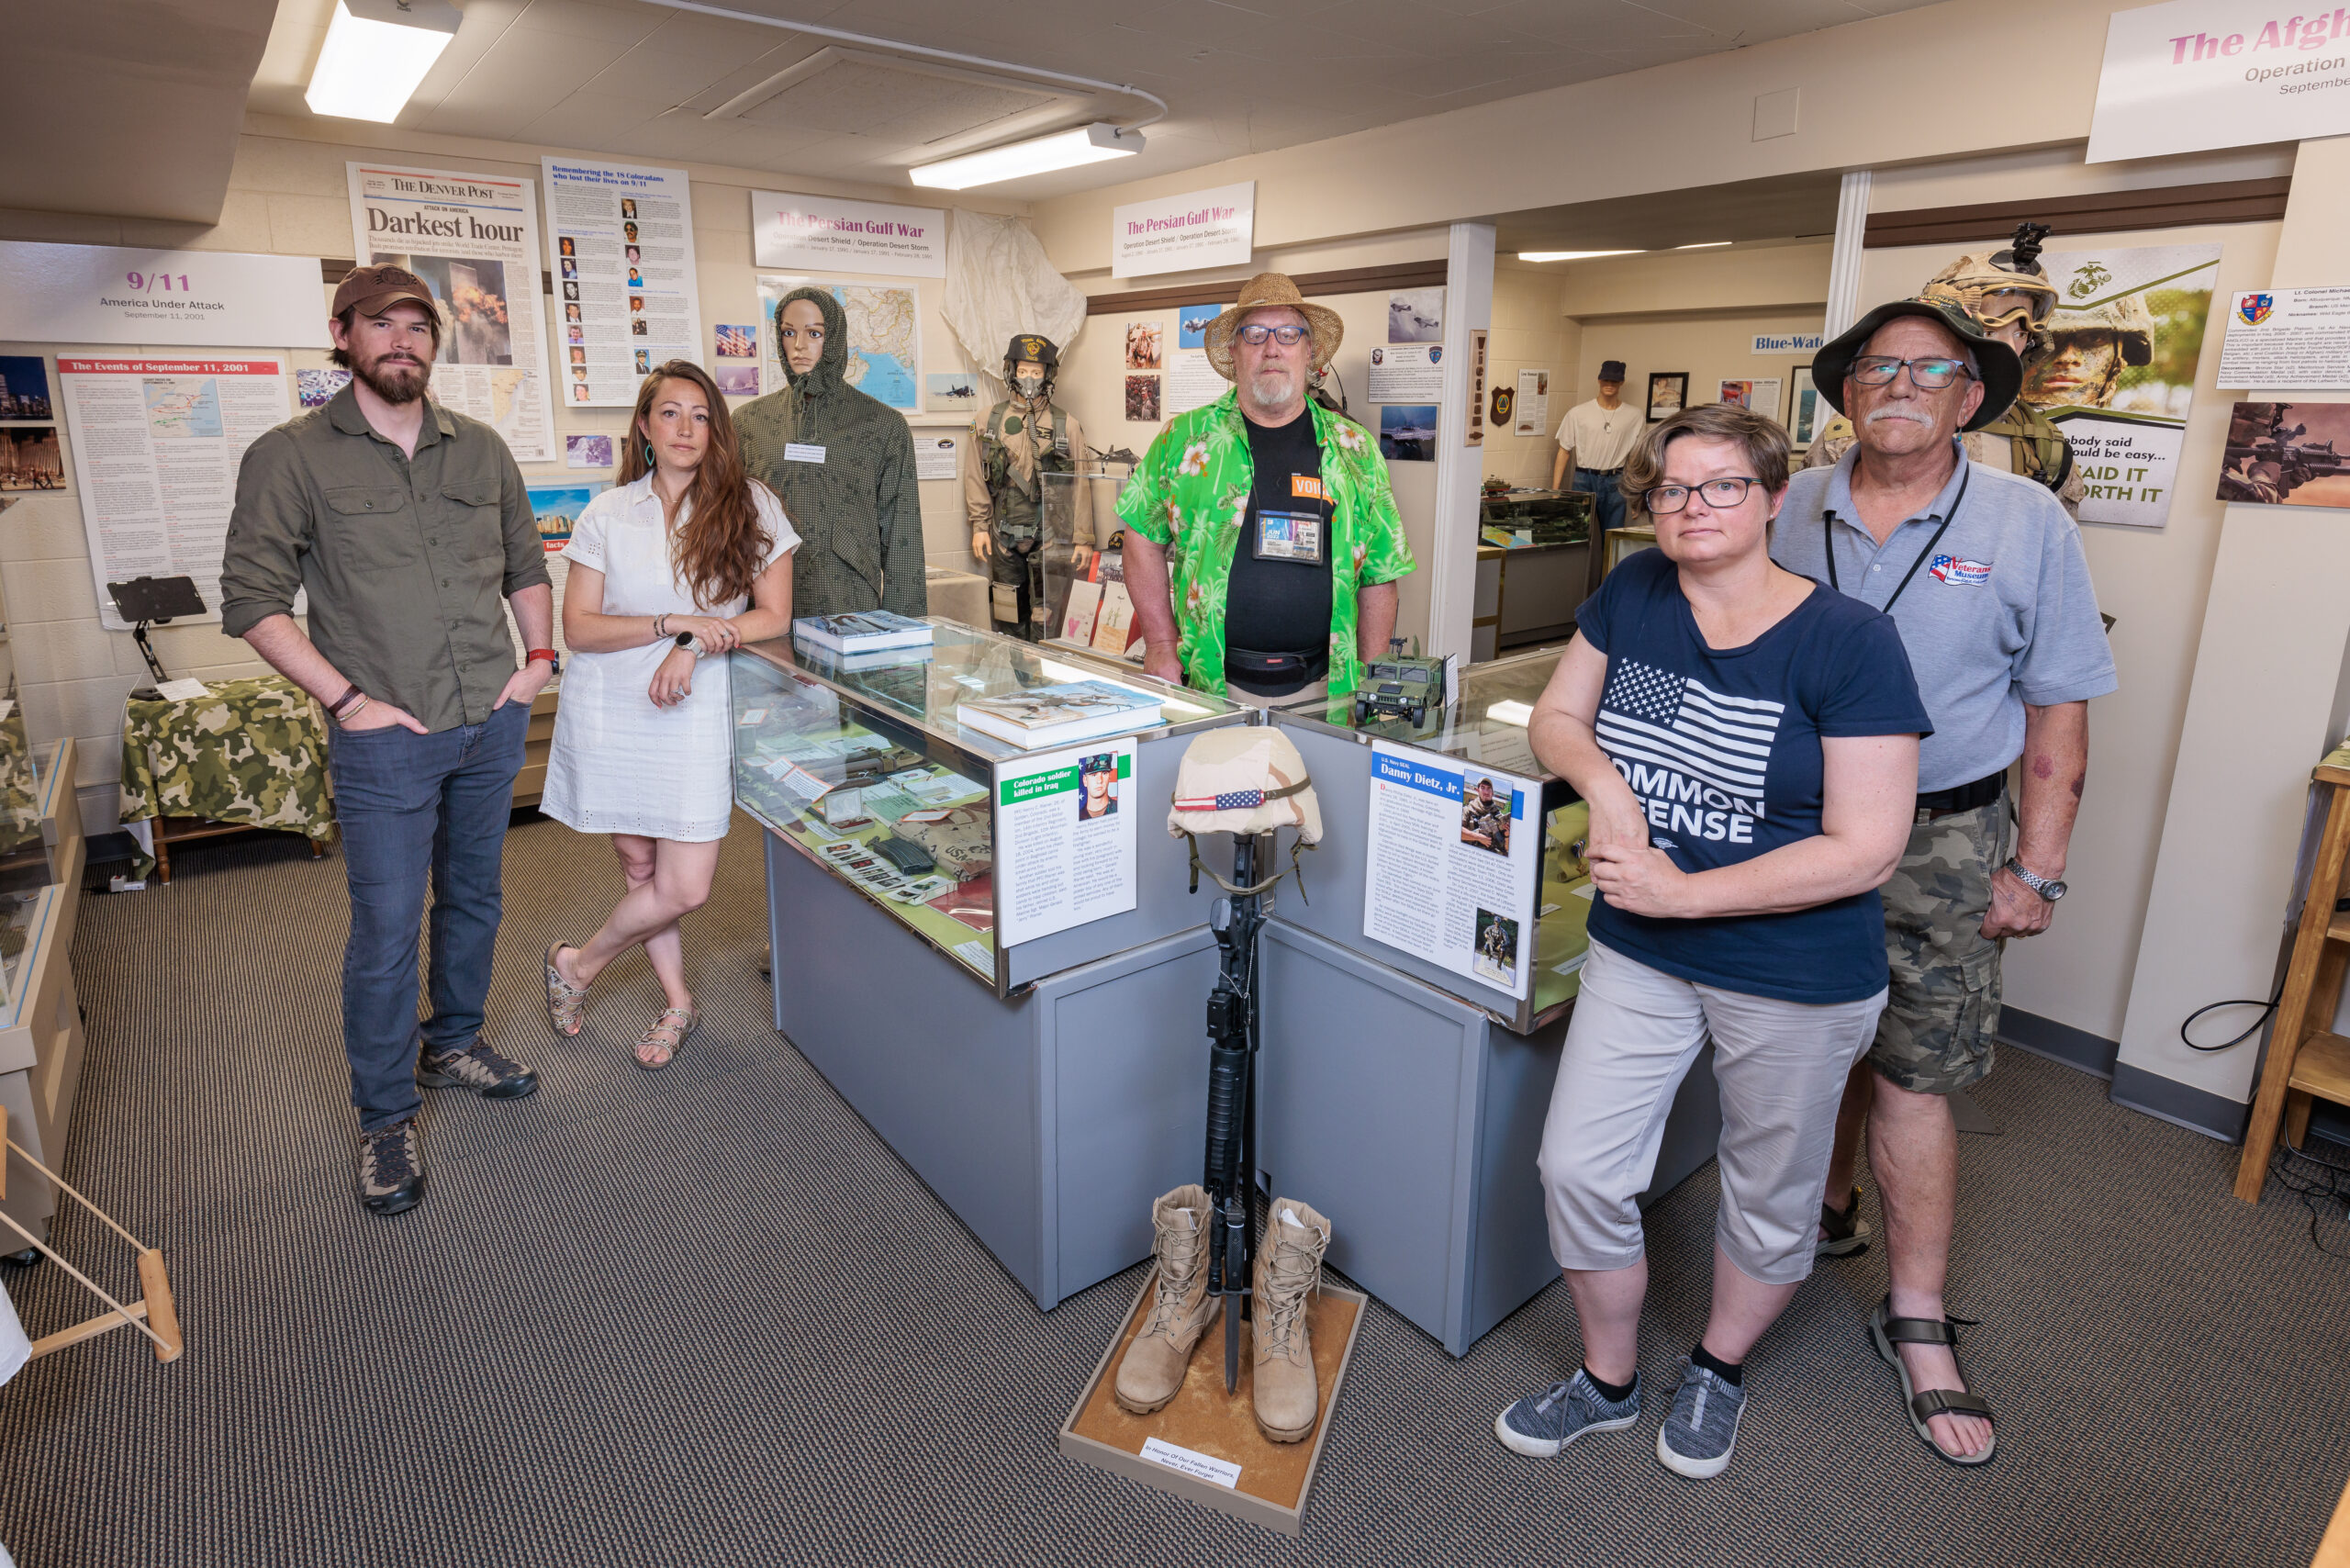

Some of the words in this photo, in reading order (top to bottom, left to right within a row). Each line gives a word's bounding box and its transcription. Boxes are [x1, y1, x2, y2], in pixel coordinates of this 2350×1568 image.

[2169, 33, 2244, 64] The
[2245, 56, 2345, 83] Operation
[553, 165, 601, 176] Remembering
[626, 173, 664, 182] Coloradans
[391, 178, 417, 192] THE
[420, 181, 465, 196] DENVER
[468, 185, 494, 198] POST
[367, 207, 463, 238] Darkest
[469, 217, 523, 241] hour
[777, 211, 804, 226] The
[808, 214, 862, 232] Persian
[866, 220, 894, 235] Gulf
[898, 223, 924, 238] War
[1127, 220, 1144, 235] The
[1147, 215, 1185, 231] Persian
[1187, 208, 1210, 225] Gulf
[1213, 207, 1235, 220] War
[808, 235, 829, 243] Desert
[831, 237, 851, 245] Shield
[857, 240, 888, 249] Operation
[1146, 238, 1160, 246] Desert
[1161, 235, 1175, 244] Shield
[1180, 233, 1203, 241] Operation
[127, 272, 189, 294] 9/11
[100, 297, 149, 308] America
[152, 299, 185, 308] Under
[189, 301, 225, 310] Attack
[125, 311, 167, 319] September
[72, 362, 92, 370] The
[95, 363, 129, 371] Events
[132, 363, 142, 371] of
[146, 364, 199, 372] September
[203, 364, 220, 373] 11,
[223, 364, 249, 372] 2001
[2064, 435, 2100, 448] obody
[2106, 437, 2132, 446] said
[2073, 448, 2099, 457] ould
[2105, 448, 2120, 458] be
[2125, 453, 2165, 462] easy...
[2078, 465, 2119, 480] AID
[2127, 468, 2148, 482] IT
[1296, 479, 1330, 496] VOIC
[2141, 488, 2163, 502] IT
[1952, 556, 1990, 573] Veterans
[1954, 570, 1988, 578] Museum
[1013, 776, 1046, 789] Colorado
[1047, 770, 1071, 780] soldier
[1381, 764, 1412, 782] Danny
[1415, 773, 1443, 791] Dietz,
[1446, 782, 1460, 795] Jr.
[1611, 757, 1764, 819] OMMON
[1013, 787, 1033, 798] killed
[1637, 794, 1753, 844] ENSE
[1152, 1447, 1169, 1457] Honor
[1191, 1460, 1208, 1470] Fallen
[1161, 1458, 1179, 1468] Never,
[1181, 1464, 1193, 1473] Ever
[1194, 1469, 1214, 1479] Forget
